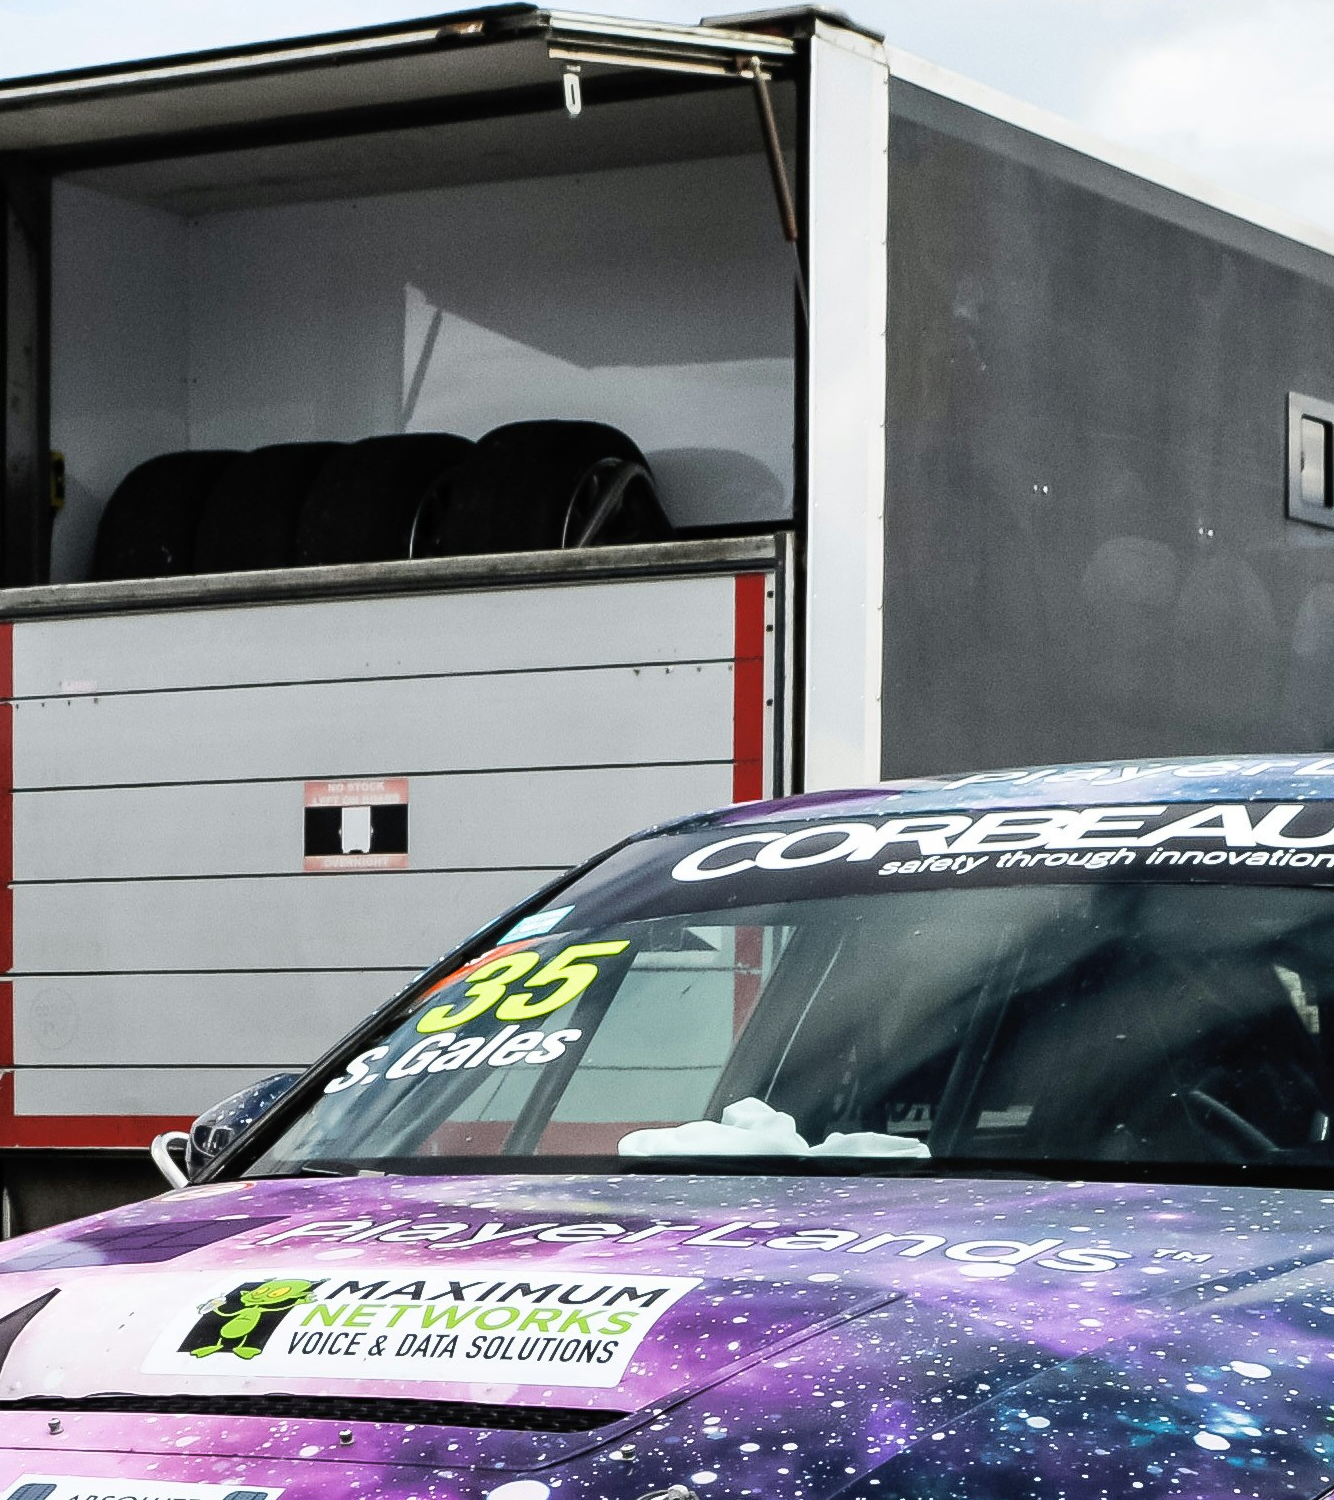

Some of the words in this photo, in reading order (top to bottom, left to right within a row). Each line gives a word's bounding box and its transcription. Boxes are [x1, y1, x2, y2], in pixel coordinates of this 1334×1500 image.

[878, 854, 989, 876] safety
[996, 849, 1137, 870] through
[417, 940, 630, 1034] 35
[253, 1216, 1133, 1273] PlayerLands
[340, 1280, 670, 1308] MAXIMUM
[300, 1304, 641, 1335] NETWORKS
[288, 1332, 364, 1358] VOICE
[368, 1335, 388, 1358] &
[396, 1334, 458, 1359] DATA
[465, 1336, 619, 1365] SOLUTIONS
